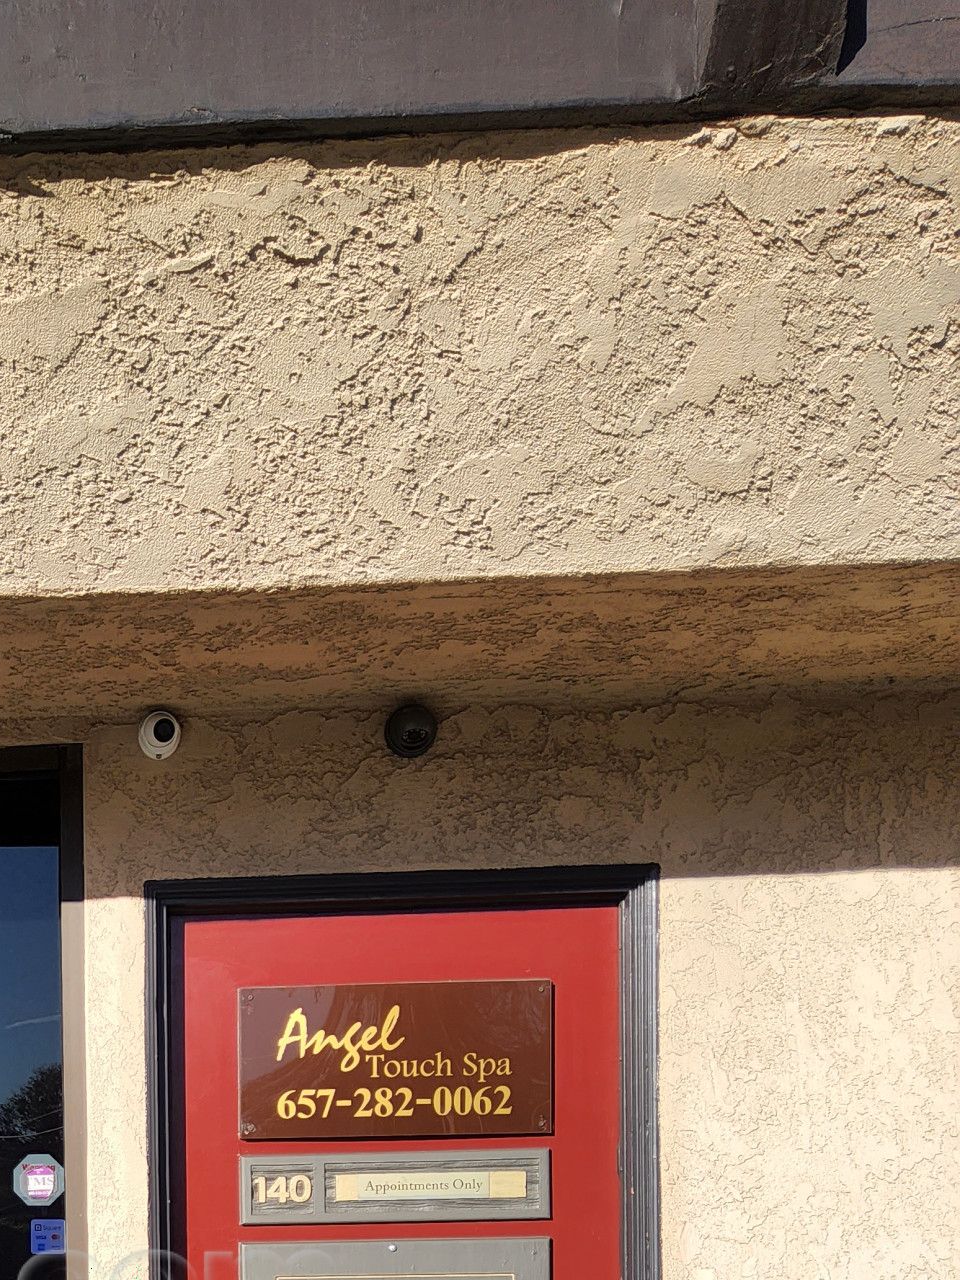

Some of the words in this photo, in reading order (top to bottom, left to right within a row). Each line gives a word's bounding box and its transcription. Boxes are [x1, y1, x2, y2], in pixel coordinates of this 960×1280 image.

[276, 1004, 405, 1072] Angel
[365, 1052, 452, 1078] Touch
[462, 1052, 512, 1082] Spa
[276, 1085, 513, 1119] 657-282-0062
[252, 1174, 313, 1203] 140
[365, 1180, 449, 1194] Appointments
[452, 1178, 483, 1192] Only
